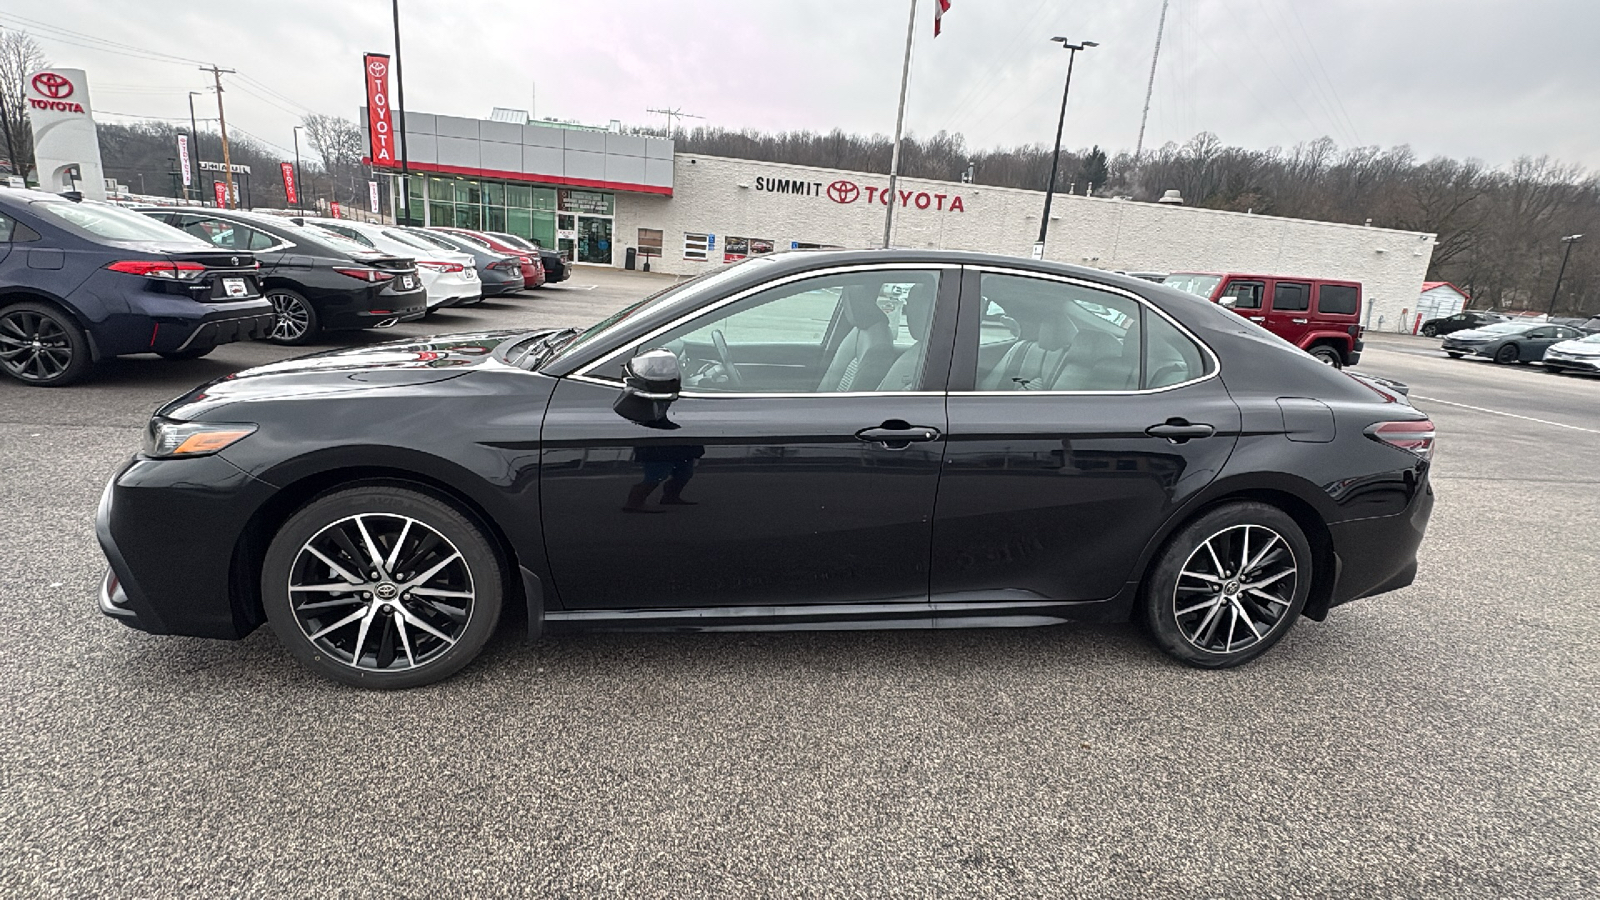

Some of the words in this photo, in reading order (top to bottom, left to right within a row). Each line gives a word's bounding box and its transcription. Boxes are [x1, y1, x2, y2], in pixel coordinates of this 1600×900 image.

[28, 98, 85, 114] TOYOTA
[374, 80, 390, 160] TOYOTA
[755, 176, 822, 197] SUMMIT
[864, 186, 964, 213] TOYOTA
